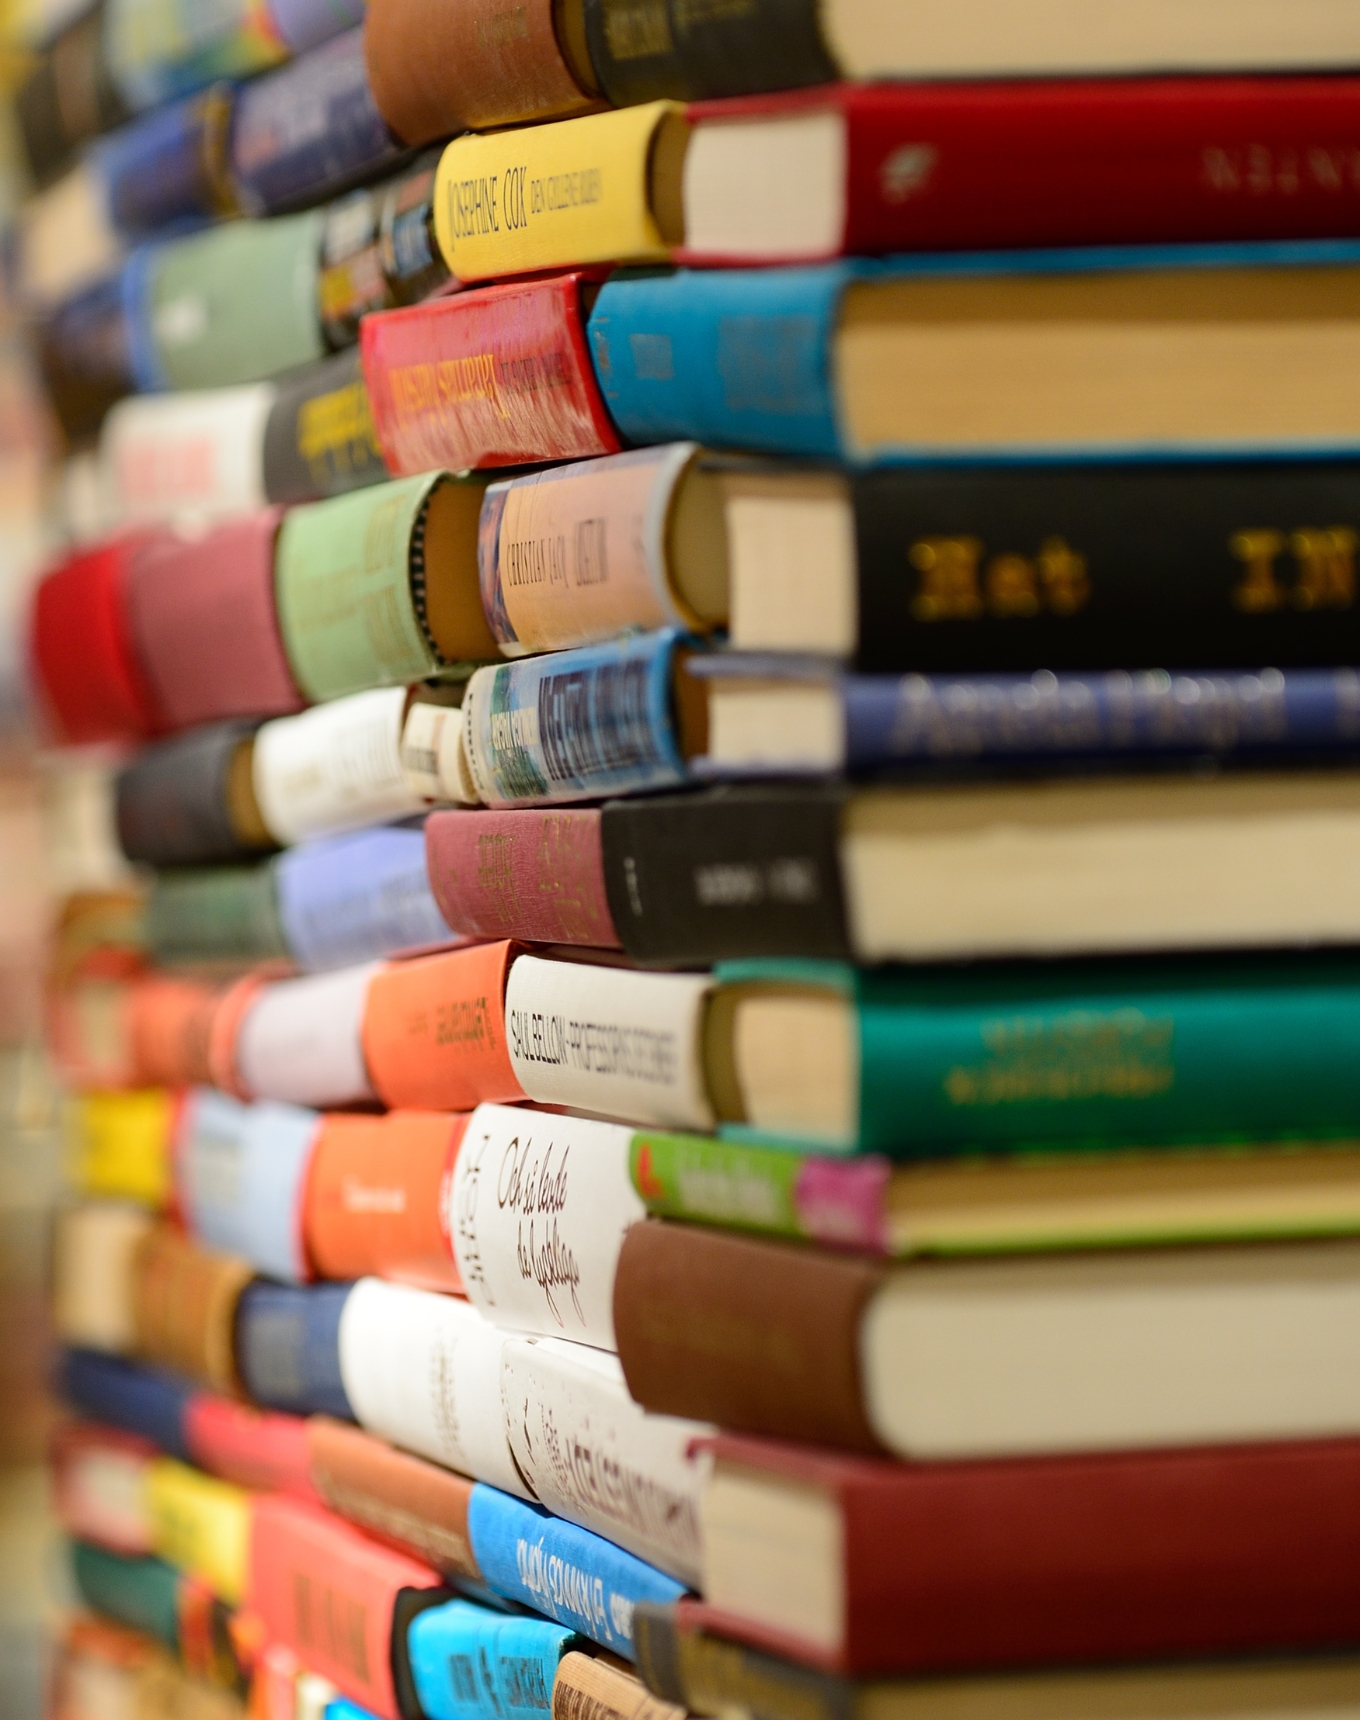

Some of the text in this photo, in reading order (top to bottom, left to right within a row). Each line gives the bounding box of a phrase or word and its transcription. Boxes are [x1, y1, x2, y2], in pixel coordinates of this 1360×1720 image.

[447, 176, 500, 251] JOSEPHINE
[503, 166, 528, 230] COX
[510, 1009, 535, 1061] SAUL
[532, 1012, 569, 1065] BELLOW
